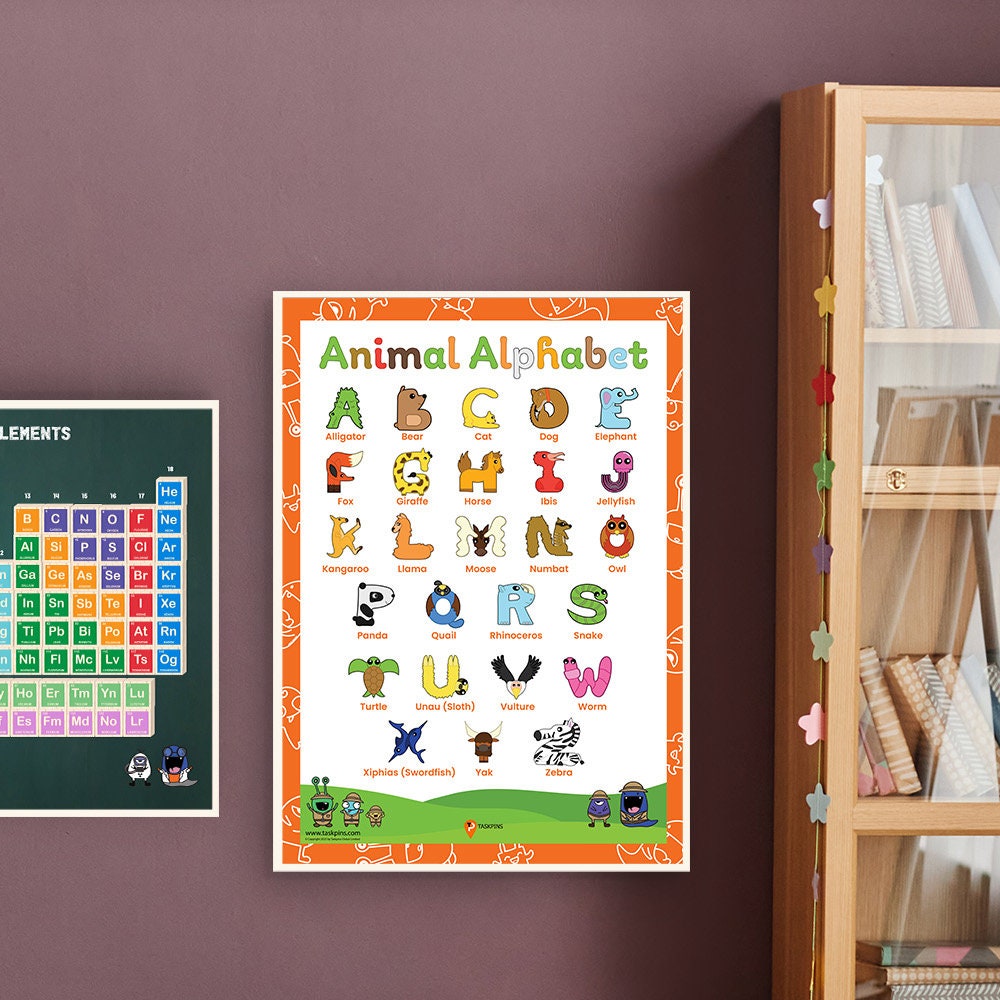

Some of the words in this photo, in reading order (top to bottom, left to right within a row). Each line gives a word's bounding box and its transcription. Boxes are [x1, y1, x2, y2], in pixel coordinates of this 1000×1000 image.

[319, 336, 460, 369] Animal
[469, 336, 648, 379] Alphabet
[326, 432, 365, 442] Alligator
[540, 433, 558, 442] Dog
[595, 433, 636, 442] Elephant
[162, 487, 177, 496] He
[397, 497, 428, 505] Giraffe
[541, 497, 557, 505] Ibis
[597, 497, 635, 507] Jellyfish
[24, 514, 31, 523] B
[51, 514, 59, 523] C
[80, 514, 88, 524] N
[108, 515, 117, 524] O
[138, 514, 144, 523] F
[161, 515, 177, 524] Ne
[21, 542, 32, 551] Al
[51, 542, 62, 551] Si
[81, 543, 88, 552] P
[109, 542, 116, 552] S
[135, 542, 146, 552] Cl
[162, 542, 176, 552] Ar
[19, 570, 36, 579] Ga
[105, 570, 120, 580] Se
[323, 566, 369, 575] Kangaroo
[49, 570, 65, 581] Ge
[77, 571, 92, 581] As
[134, 571, 148, 580] Br
[162, 571, 176, 580] Kr
[432, 631, 456, 640] Quail
[490, 631, 542, 639] Rhinoceros
[20, 654, 35, 664] Nh
[51, 654, 60, 664] Fl
[76, 655, 92, 664] Mc
[134, 655, 148, 665] Ts
[16, 688, 33, 698] Ho
[47, 688, 59, 698] Er
[72, 688, 89, 698] Tm
[101, 688, 116, 698] Yn
[130, 688, 145, 698] Lu
[443, 701, 474, 712] (Sloth)
[364, 768, 398, 778] Xiphias
[401, 767, 455, 778] (Swordfish)
